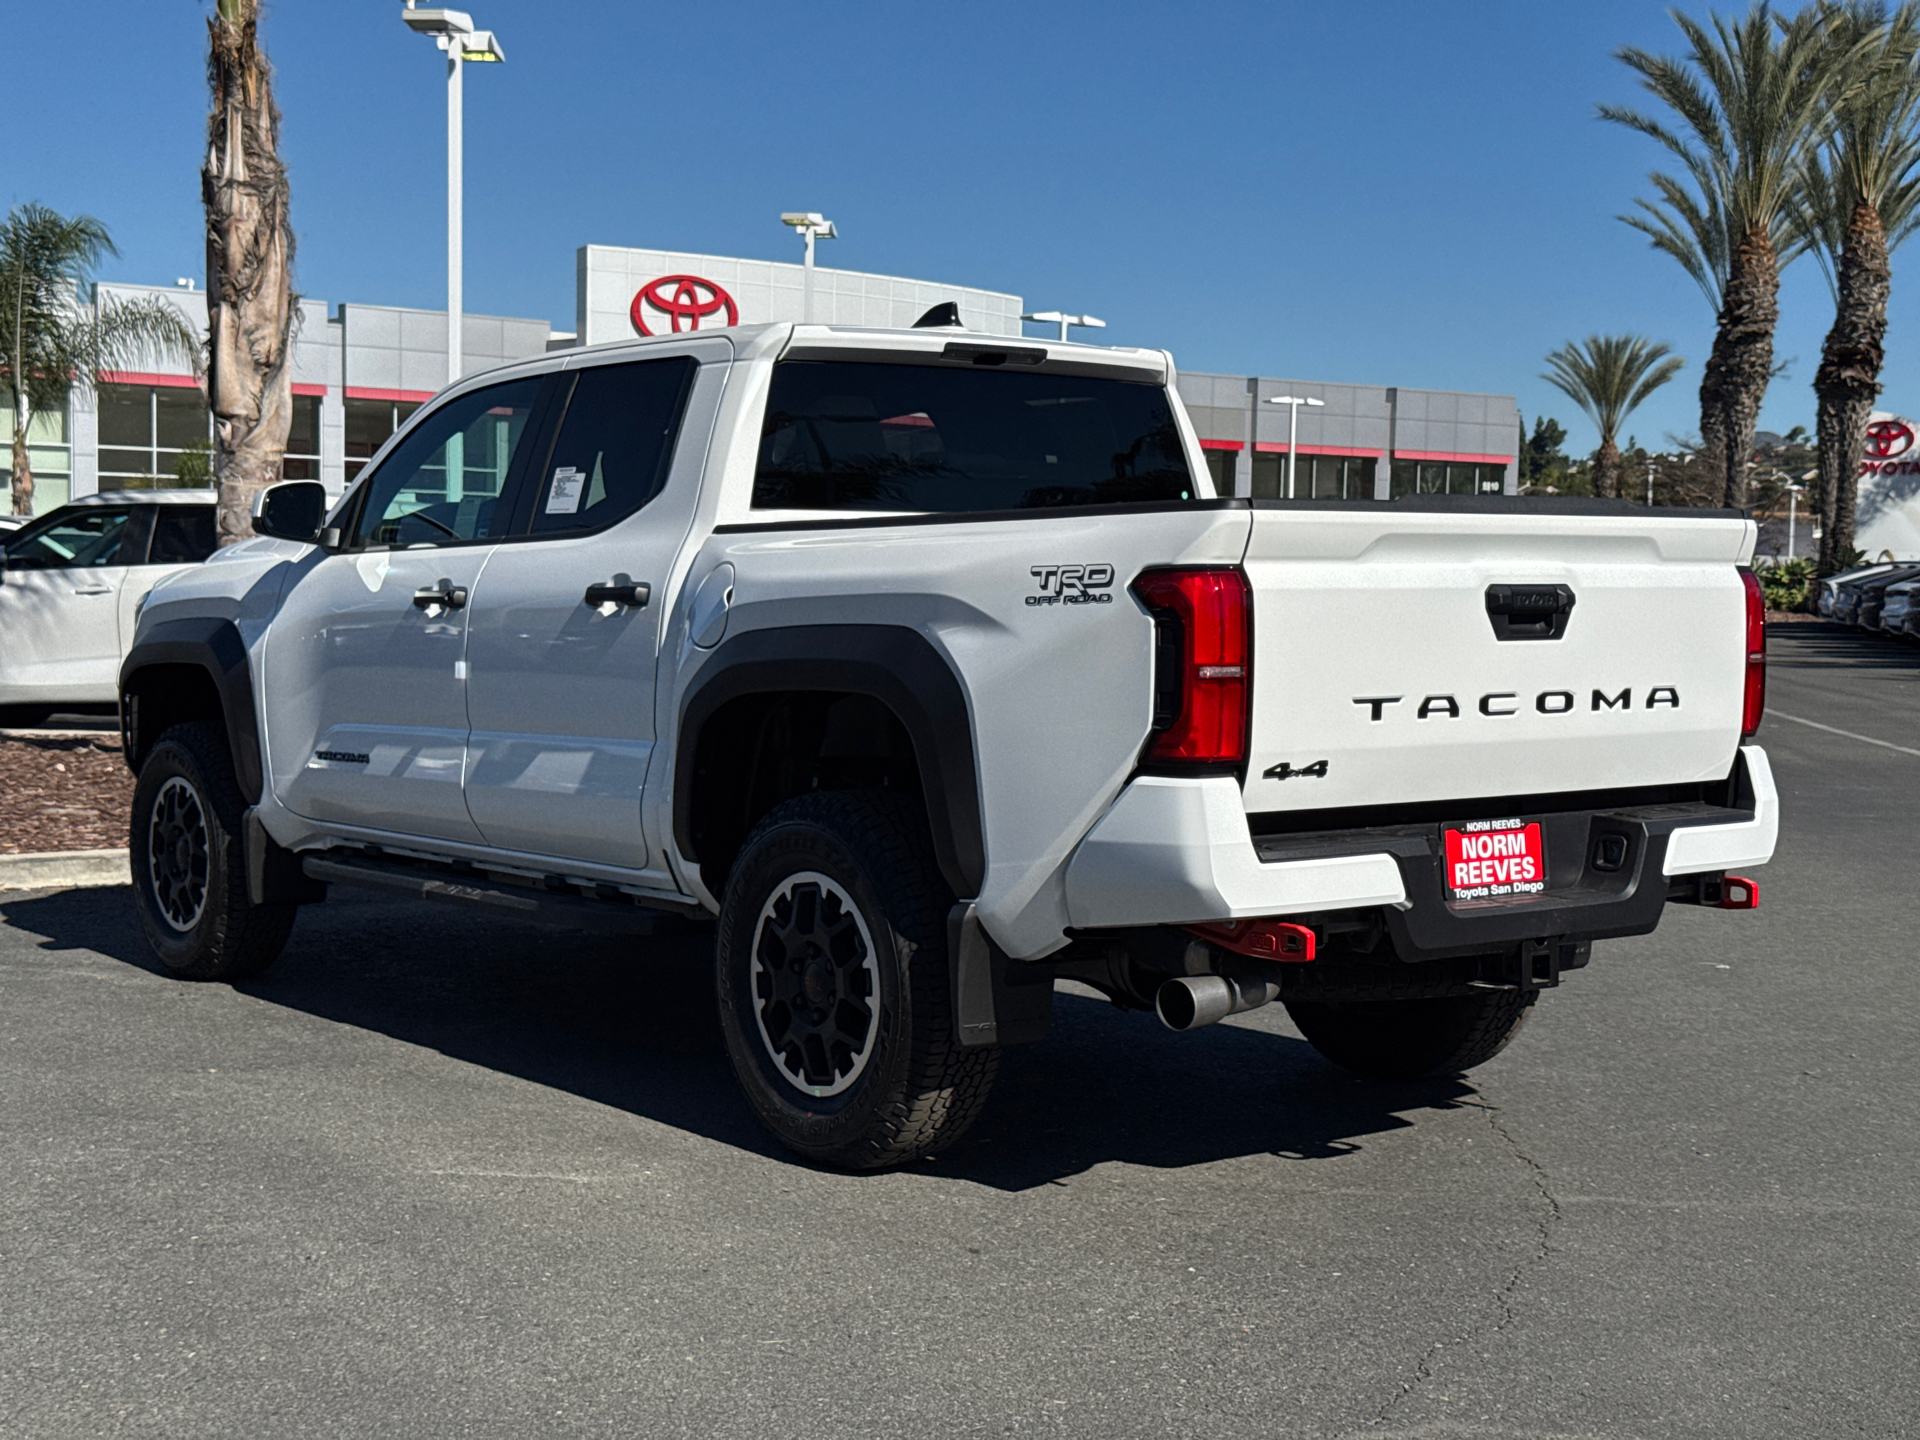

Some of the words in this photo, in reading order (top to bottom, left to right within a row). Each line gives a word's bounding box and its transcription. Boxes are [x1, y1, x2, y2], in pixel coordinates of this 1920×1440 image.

[1858, 461, 1920, 476] OYOTA
[1030, 563, 1115, 597] TRD
[1024, 595, 1061, 607] OFF
[1063, 593, 1113, 606] ROAD
[1514, 593, 1556, 606] TOYOTA
[1351, 685, 1681, 722] TACOMA
[315, 750, 370, 764] TACOMA
[1466, 820, 1490, 832] NORM
[1491, 818, 1521, 830] REEVES
[1461, 833, 1526, 860] NORM
[1454, 856, 1535, 886] REEVES
[1454, 885, 1489, 900] Toyota
[1490, 883, 1511, 895] San
[1513, 881, 1544, 894] Diego
